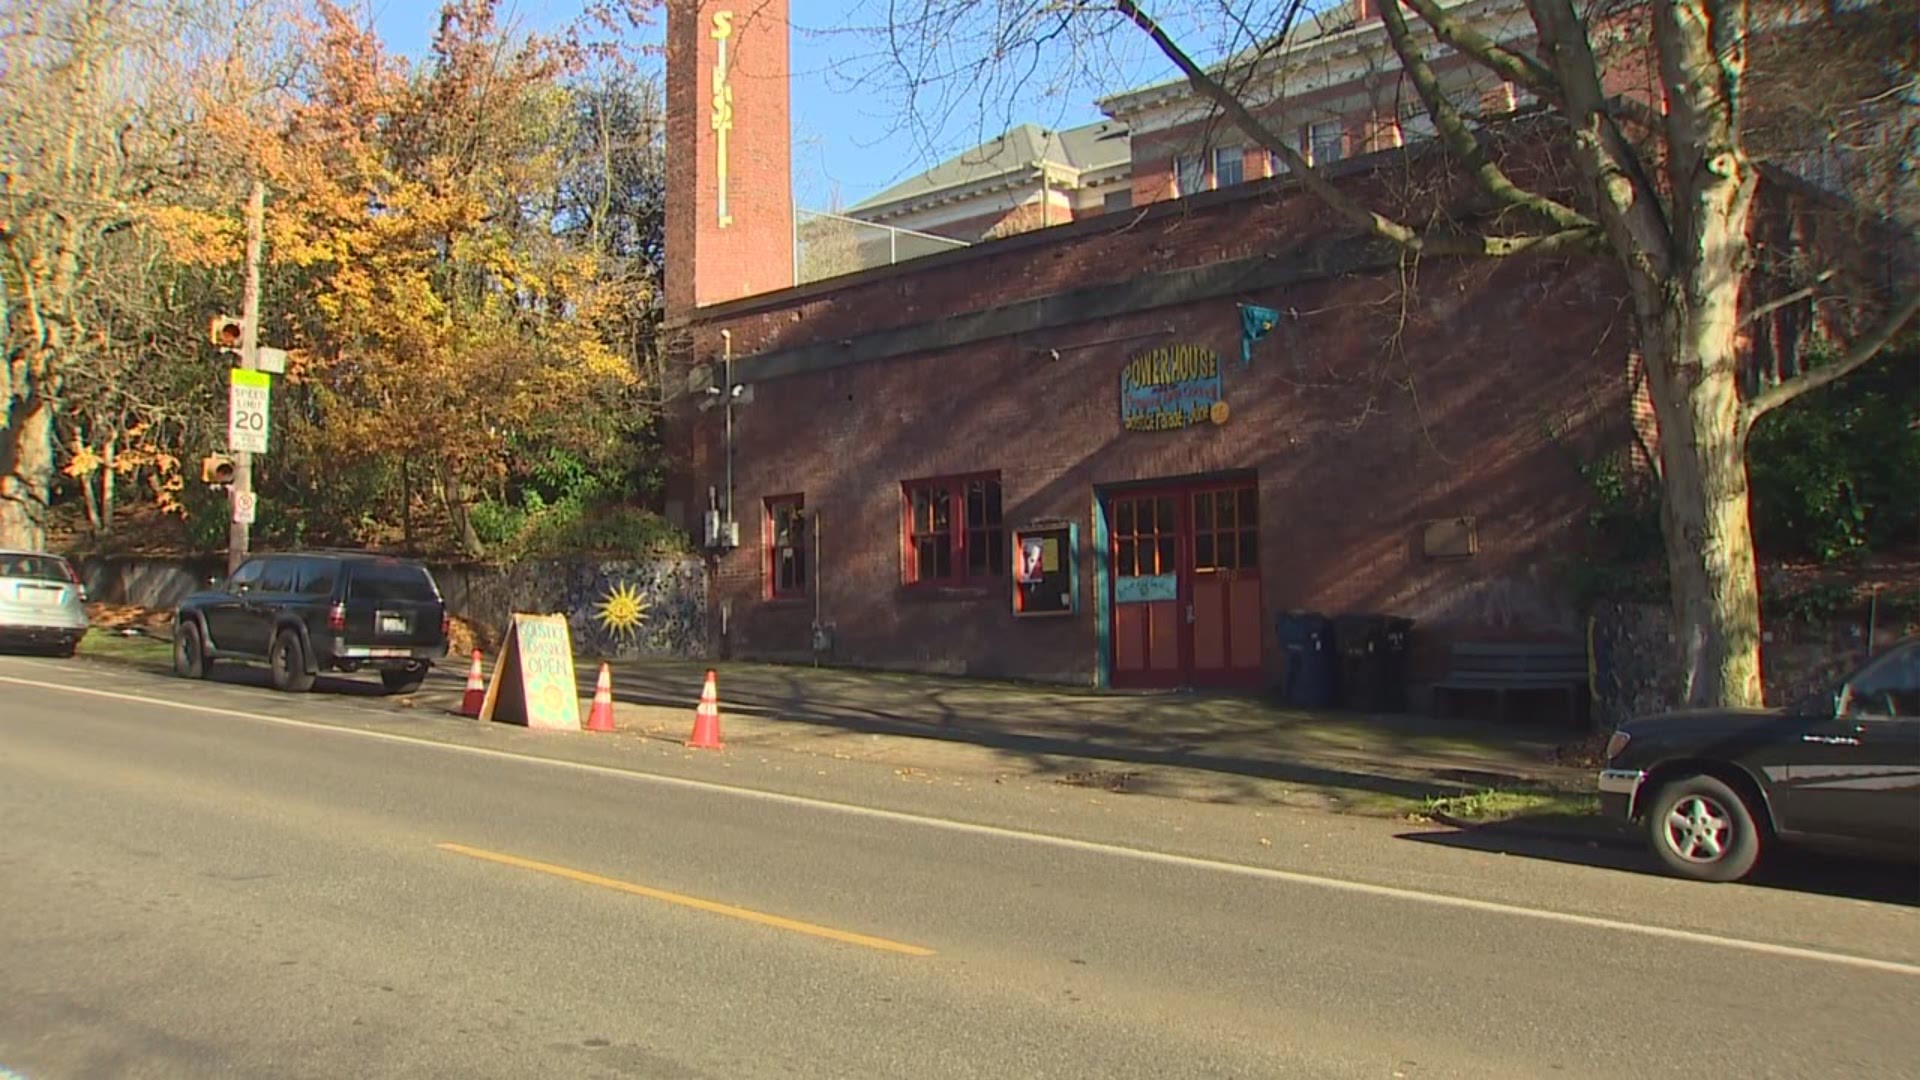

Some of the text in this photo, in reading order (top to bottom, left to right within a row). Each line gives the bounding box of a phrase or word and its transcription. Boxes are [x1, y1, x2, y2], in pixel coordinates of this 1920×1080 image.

[234, 387, 267, 398] SPEED
[235, 410, 264, 431] 20
[528, 657, 567, 674] OPEN
